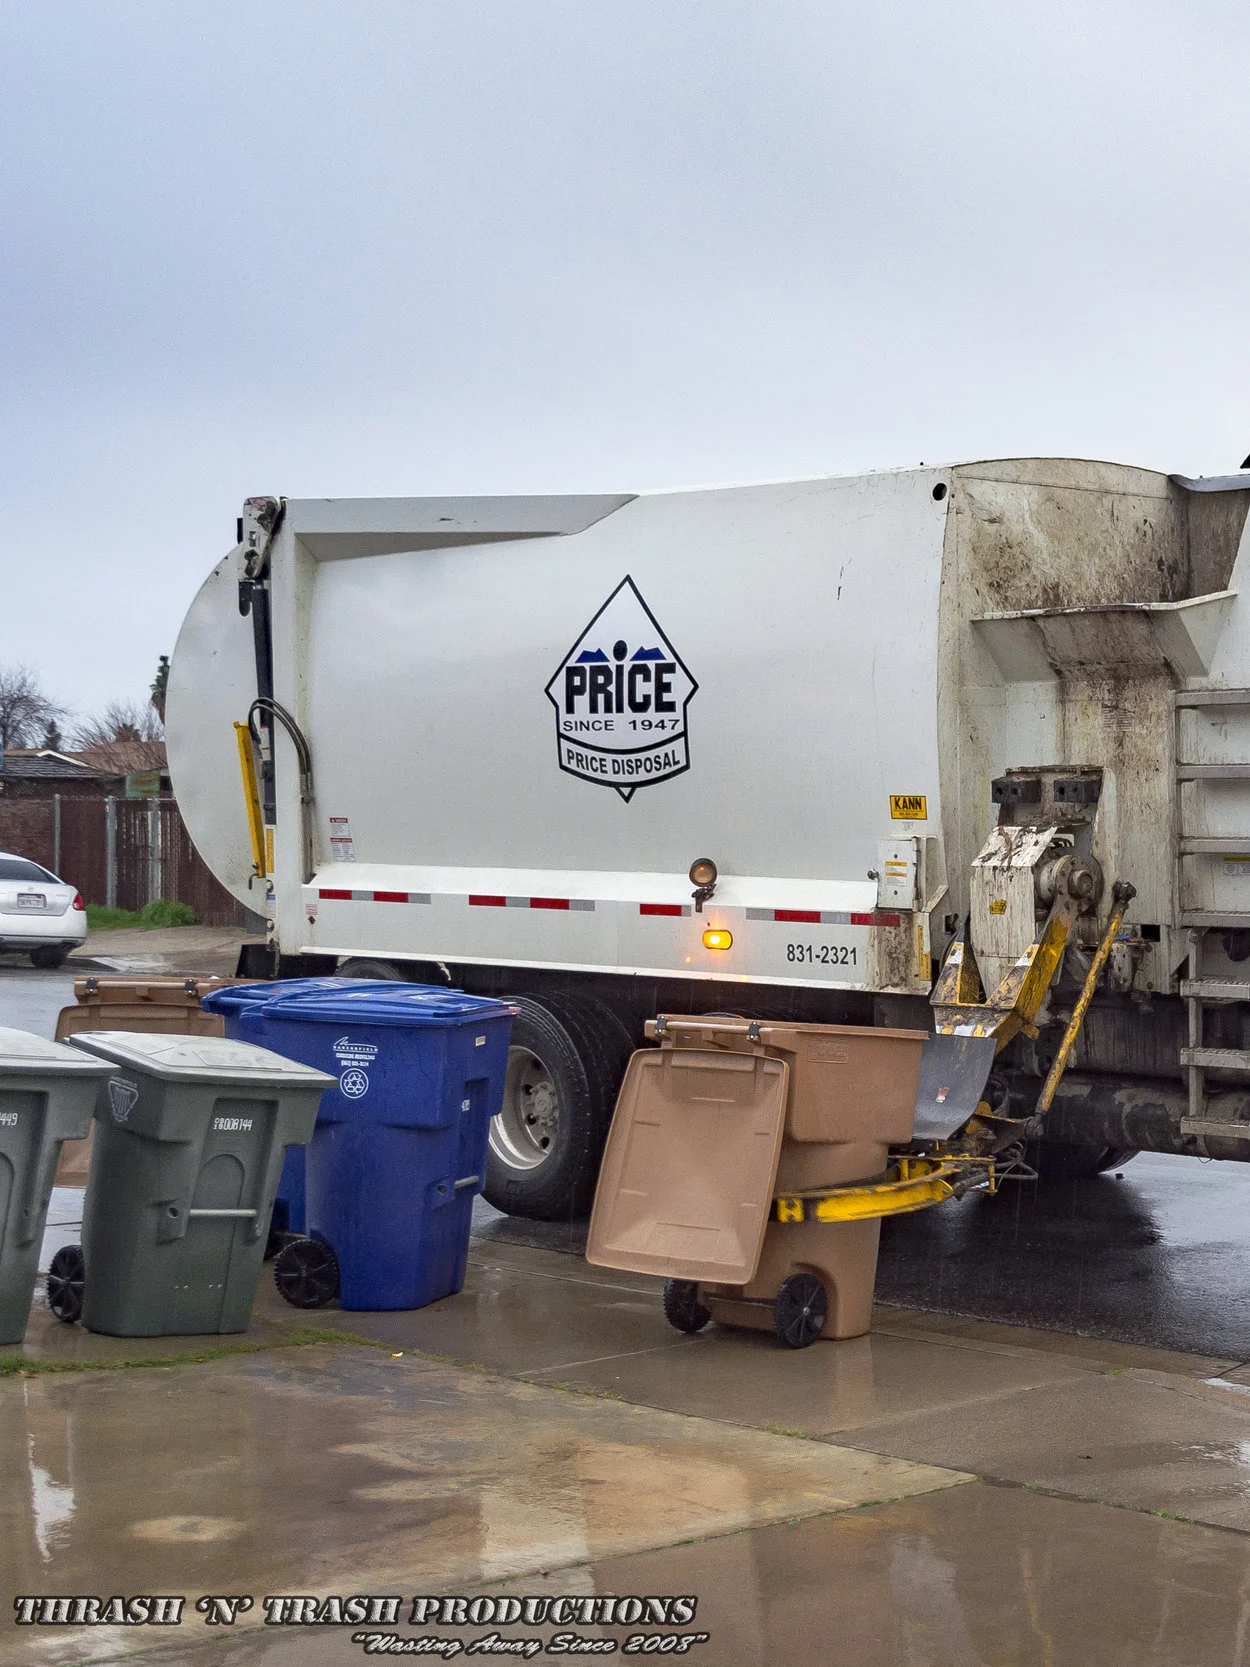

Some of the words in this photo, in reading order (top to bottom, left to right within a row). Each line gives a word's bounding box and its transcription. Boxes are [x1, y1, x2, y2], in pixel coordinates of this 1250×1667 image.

[565, 662, 677, 714] PRICE
[563, 720, 615, 732] SINCE
[628, 719, 681, 731] 1947
[566, 748, 609, 774] PRICE
[611, 749, 681, 775] DISPOSAL
[894, 797, 922, 810] KANN
[786, 943, 857, 966] 831-2321
